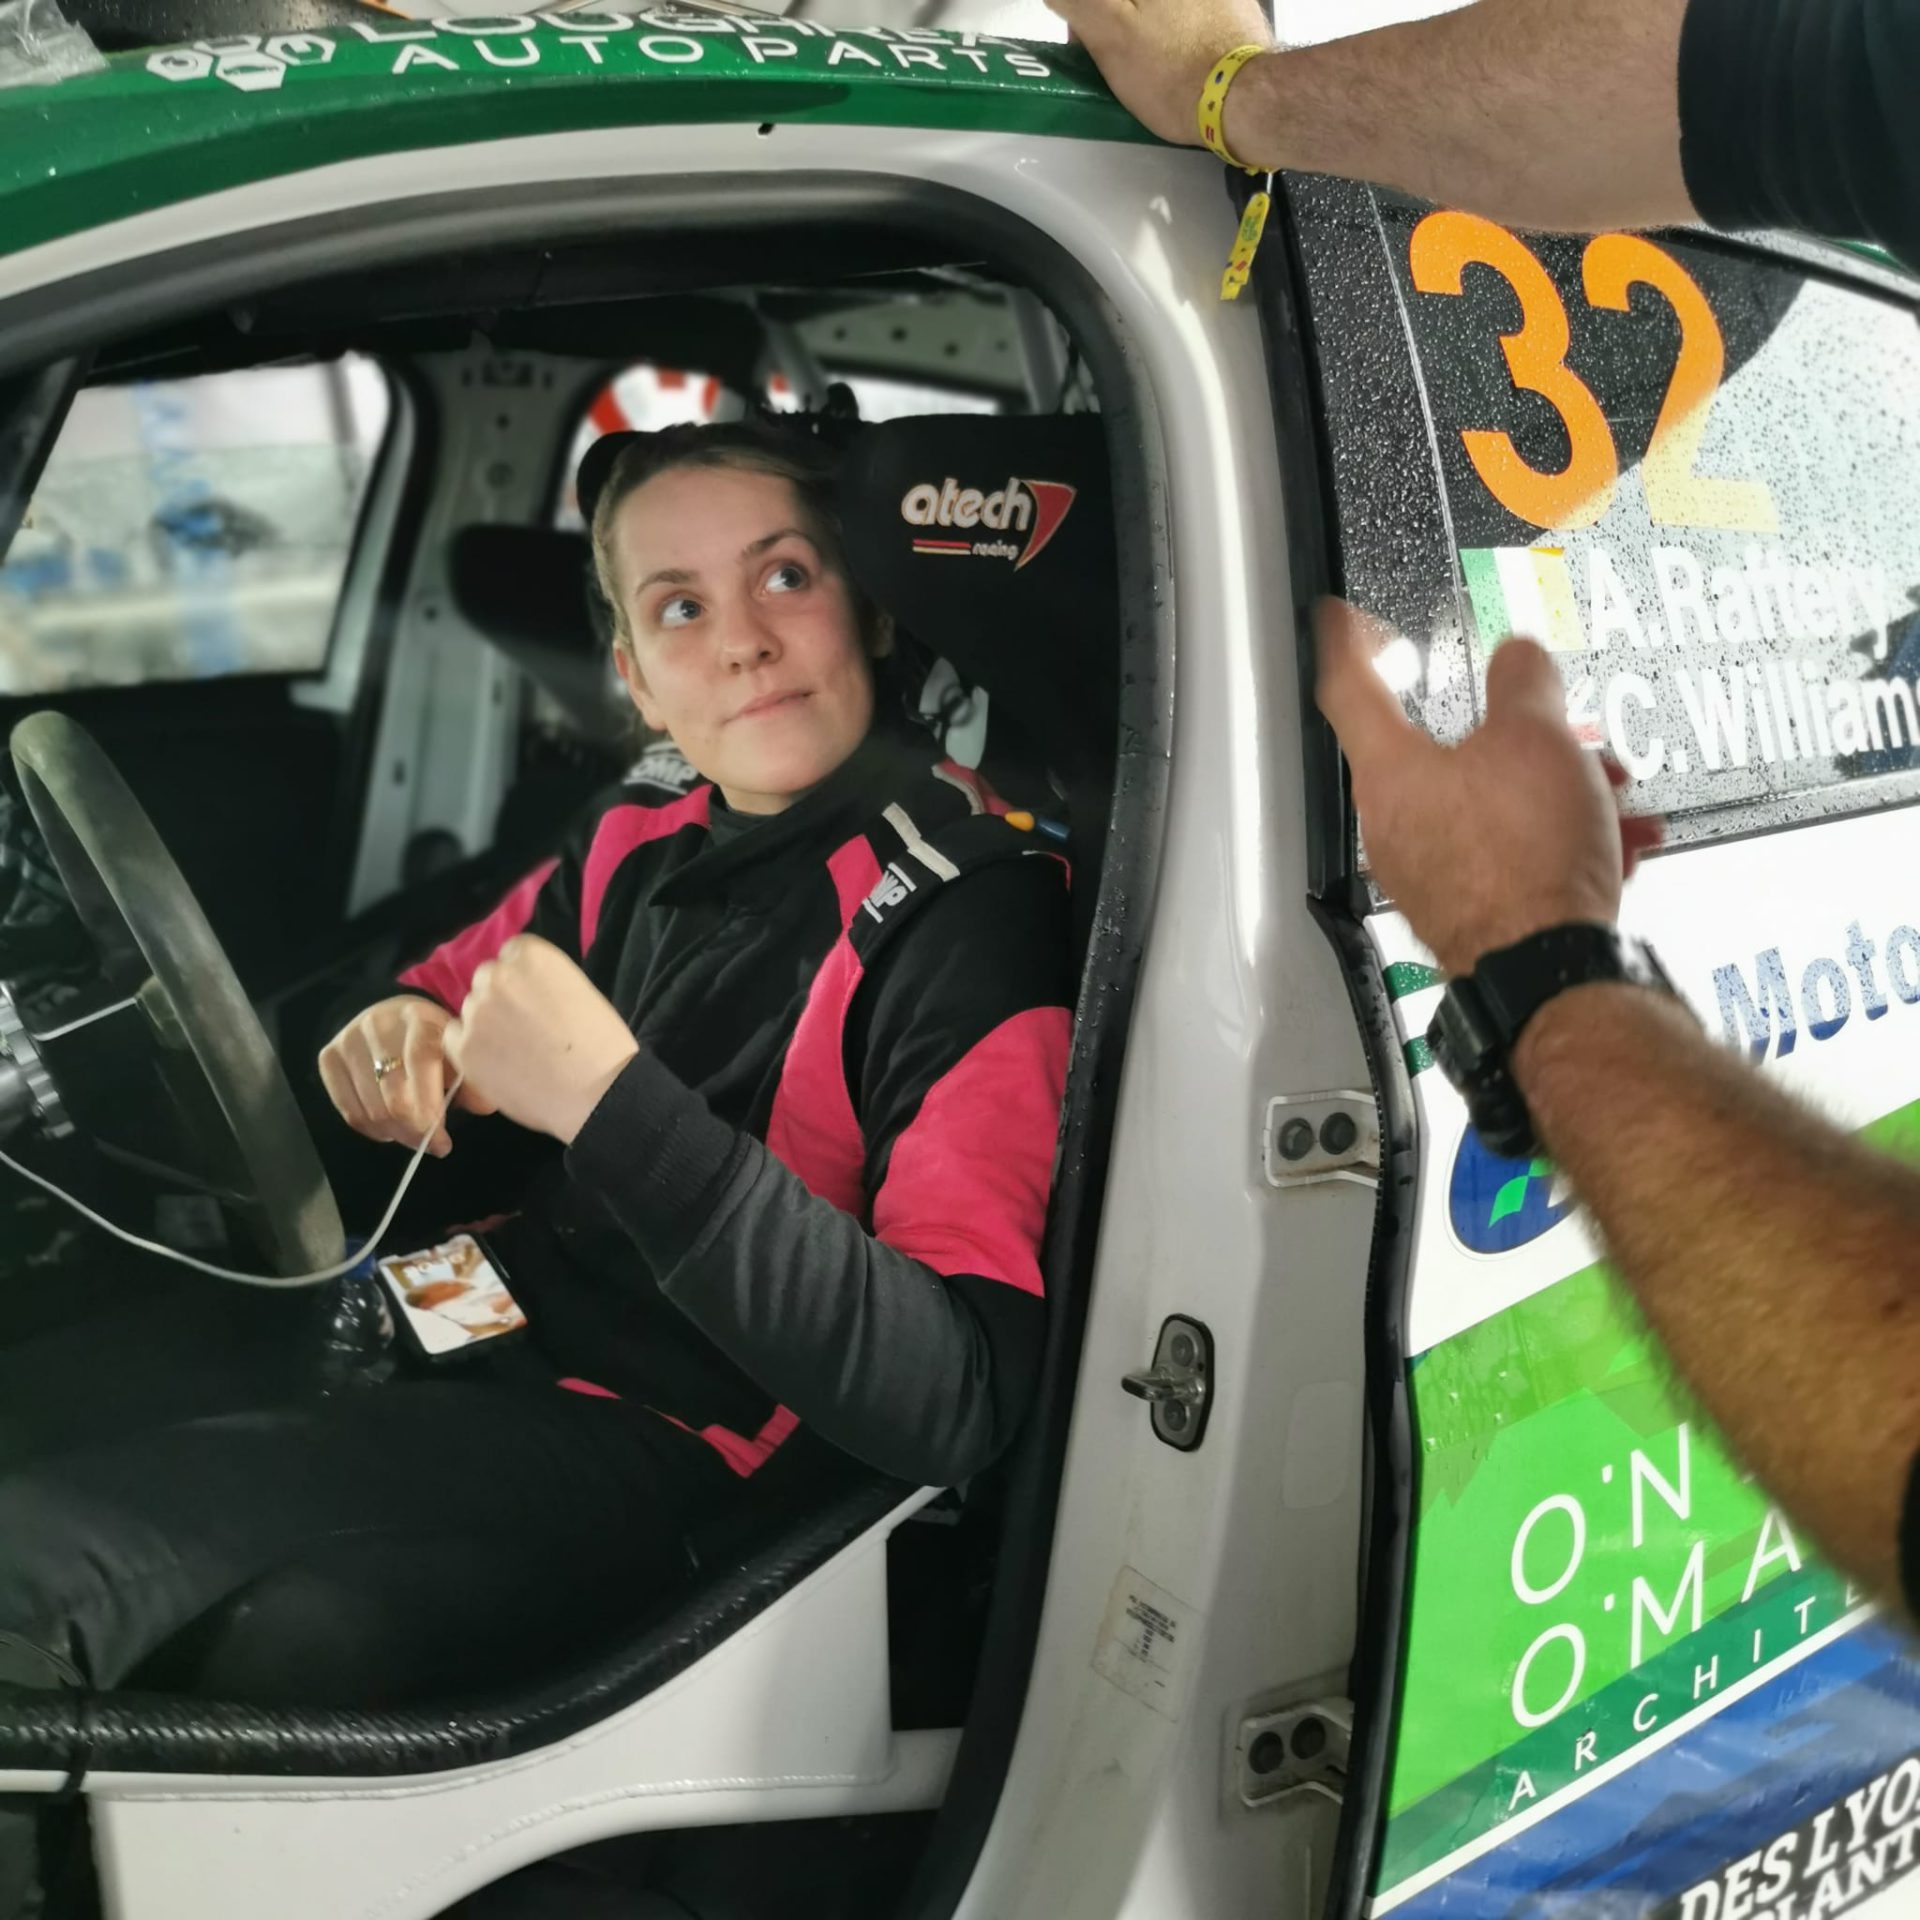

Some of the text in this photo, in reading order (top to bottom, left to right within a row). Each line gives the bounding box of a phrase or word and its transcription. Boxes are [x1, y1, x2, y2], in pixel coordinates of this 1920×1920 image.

[392, 35, 1051, 78] AUTO PARTS
[1409, 210, 1781, 533] 32
[901, 477, 1033, 532] atech
[1589, 542, 1889, 660] A.Raftery
[1605, 658, 1920, 781] C.William
[1511, 1422, 1691, 1605] O'N
[1680, 1757, 1920, 1920] DES LYO
